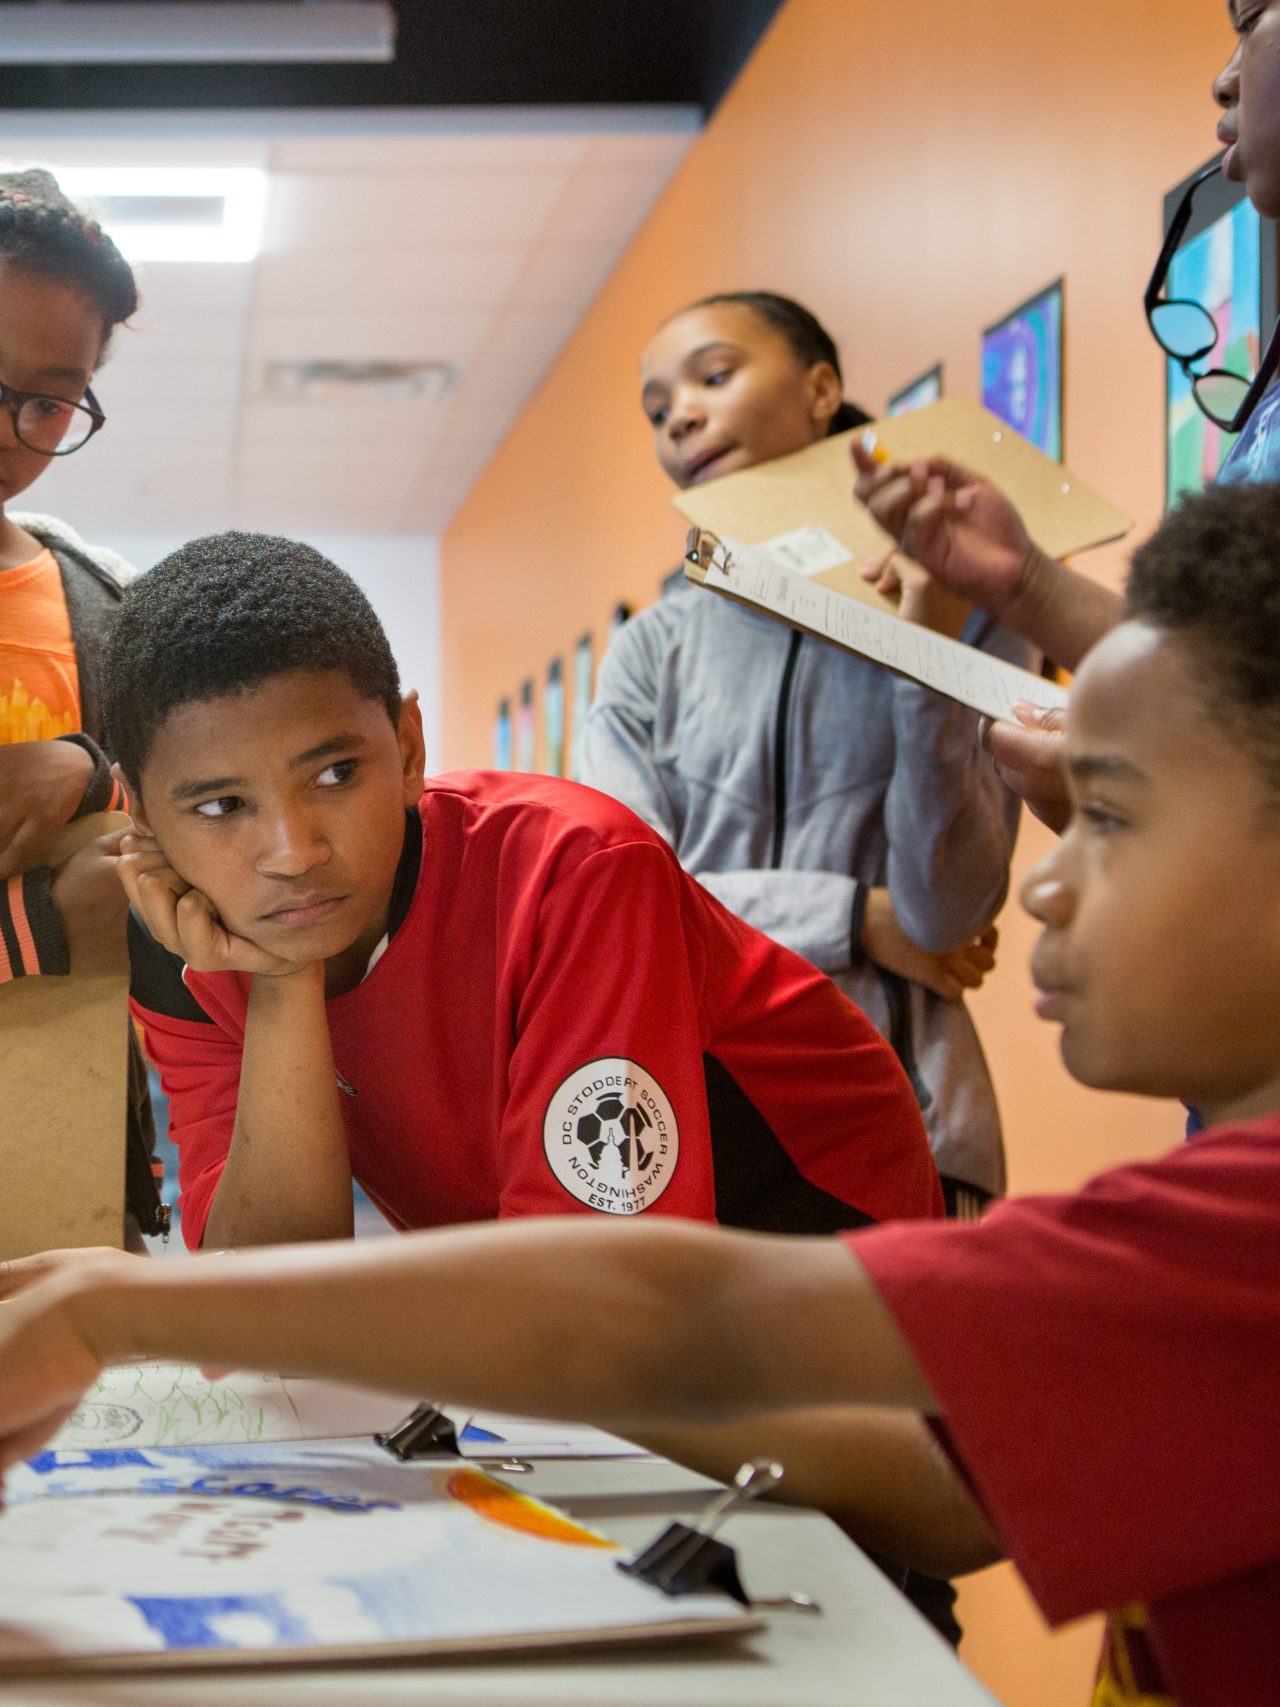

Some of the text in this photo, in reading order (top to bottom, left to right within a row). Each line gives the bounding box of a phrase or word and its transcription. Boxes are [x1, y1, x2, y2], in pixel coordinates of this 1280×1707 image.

[562, 1076, 668, 1199] DC STODDERT SOCCER WASHINGTON
[588, 1193, 646, 1212] EST. 1977
